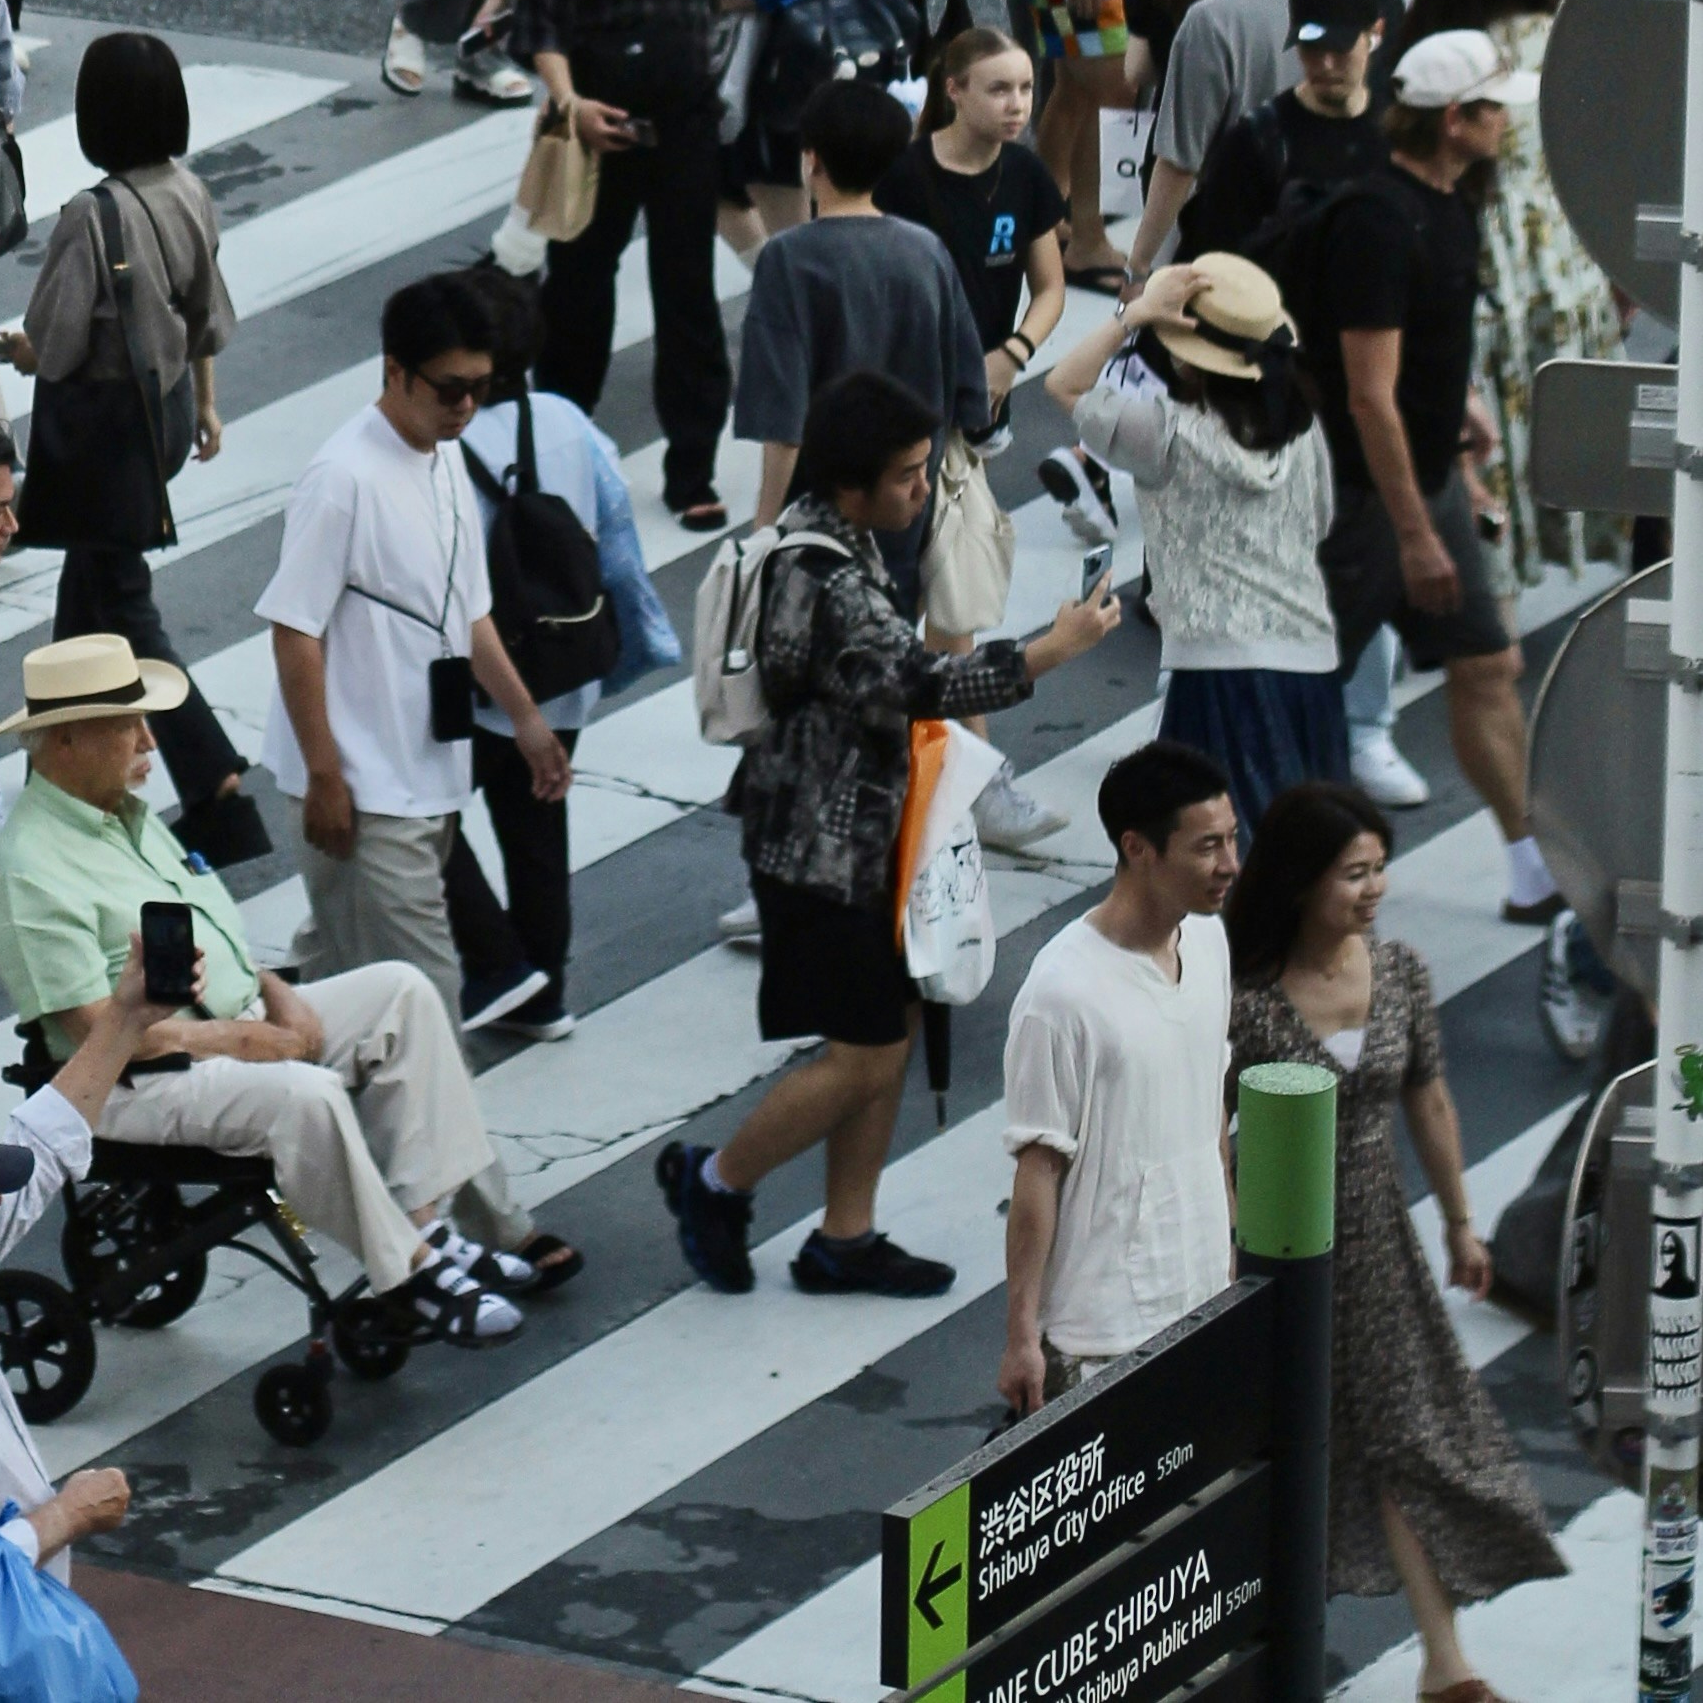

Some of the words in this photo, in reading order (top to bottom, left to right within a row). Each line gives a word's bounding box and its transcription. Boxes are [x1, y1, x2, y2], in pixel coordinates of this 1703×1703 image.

[979, 1433, 1105, 1559] 渋谷区役所
[979, 1534, 1049, 1601] Shibuya
[1054, 1507, 1088, 1547] City
[1091, 1470, 1145, 1523] Office
[1157, 1443, 1194, 1481] 550m
[1034, 1621, 1099, 1696] CUBE
[1104, 1548, 1211, 1652] SHIBUYA
[1077, 1657, 1139, 1703] Shibuya
[1143, 1620, 1189, 1673] Public
[1191, 1590, 1222, 1635] Hall
[1226, 1576, 1262, 1616] 550m
